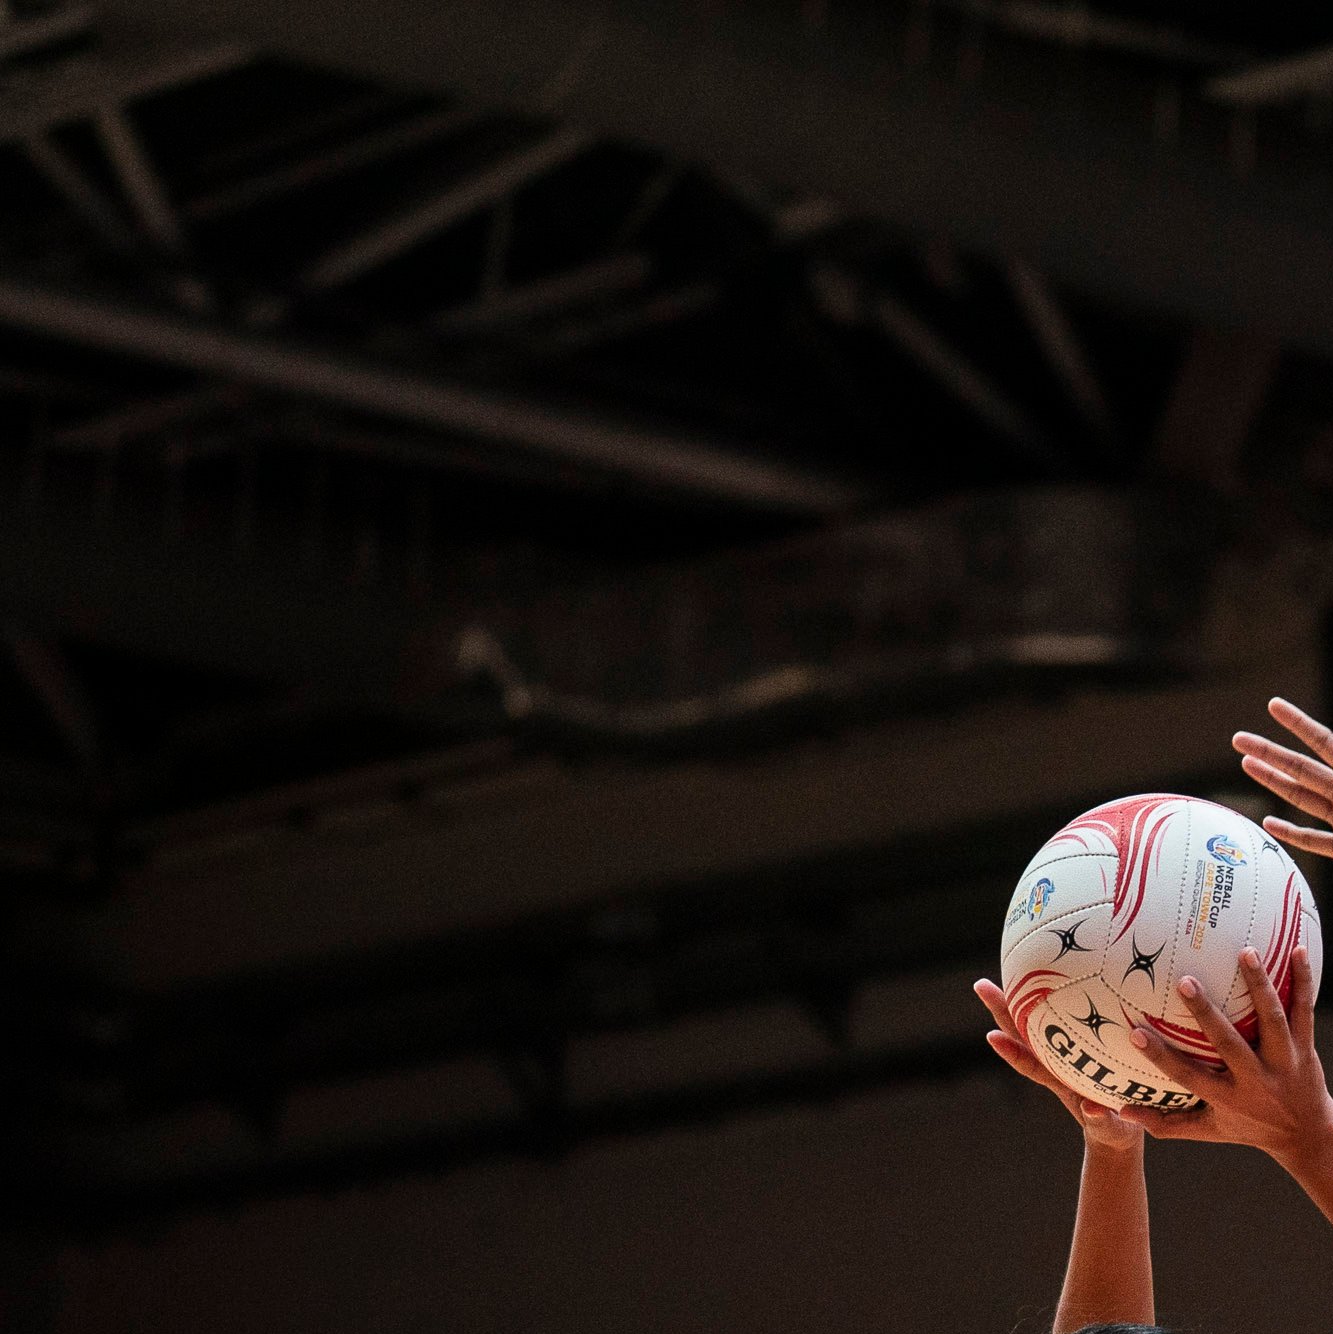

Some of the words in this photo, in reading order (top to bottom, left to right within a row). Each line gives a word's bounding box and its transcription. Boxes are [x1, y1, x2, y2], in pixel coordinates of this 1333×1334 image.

[1204, 862, 1215, 888] CAPE
[1212, 865, 1225, 904] WORLD
[1221, 866, 1234, 910] NETBALL
[1198, 891, 1212, 922] TOWN
[1208, 905, 1220, 929] CUP
[1185, 918, 1194, 935] ASIA
